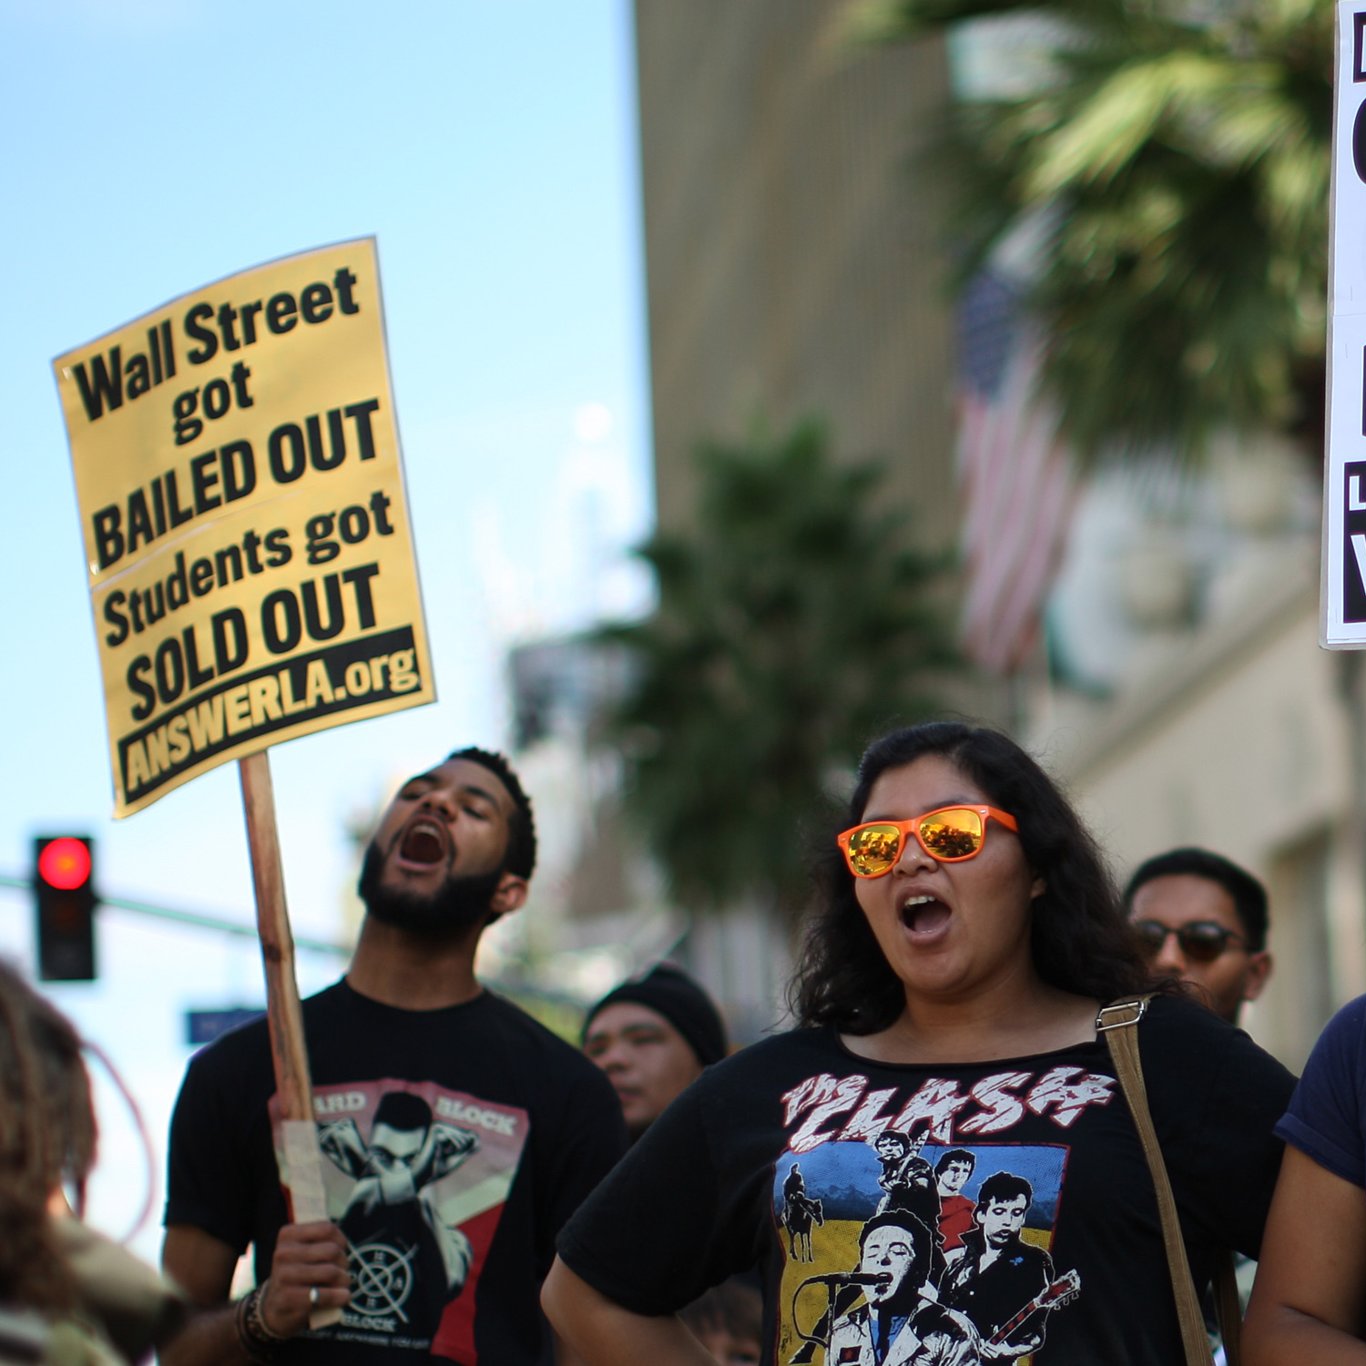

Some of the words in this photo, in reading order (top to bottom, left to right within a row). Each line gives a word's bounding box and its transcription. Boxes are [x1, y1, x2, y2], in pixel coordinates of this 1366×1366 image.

[73, 319, 176, 422] Wall
[183, 267, 360, 365] Street
[172, 361, 253, 445] got
[93, 439, 256, 573] BAILED
[268, 397, 380, 484] OUT
[103, 525, 294, 648] Students
[306, 490, 394, 564] got
[126, 606, 249, 722] SOLD
[261, 562, 380, 655] OUT
[125, 647, 420, 792] ANSWERLA.org
[313, 1092, 367, 1114] ARD
[435, 1096, 518, 1136] BLOCK
[790, 1067, 1117, 1153] CLASH
